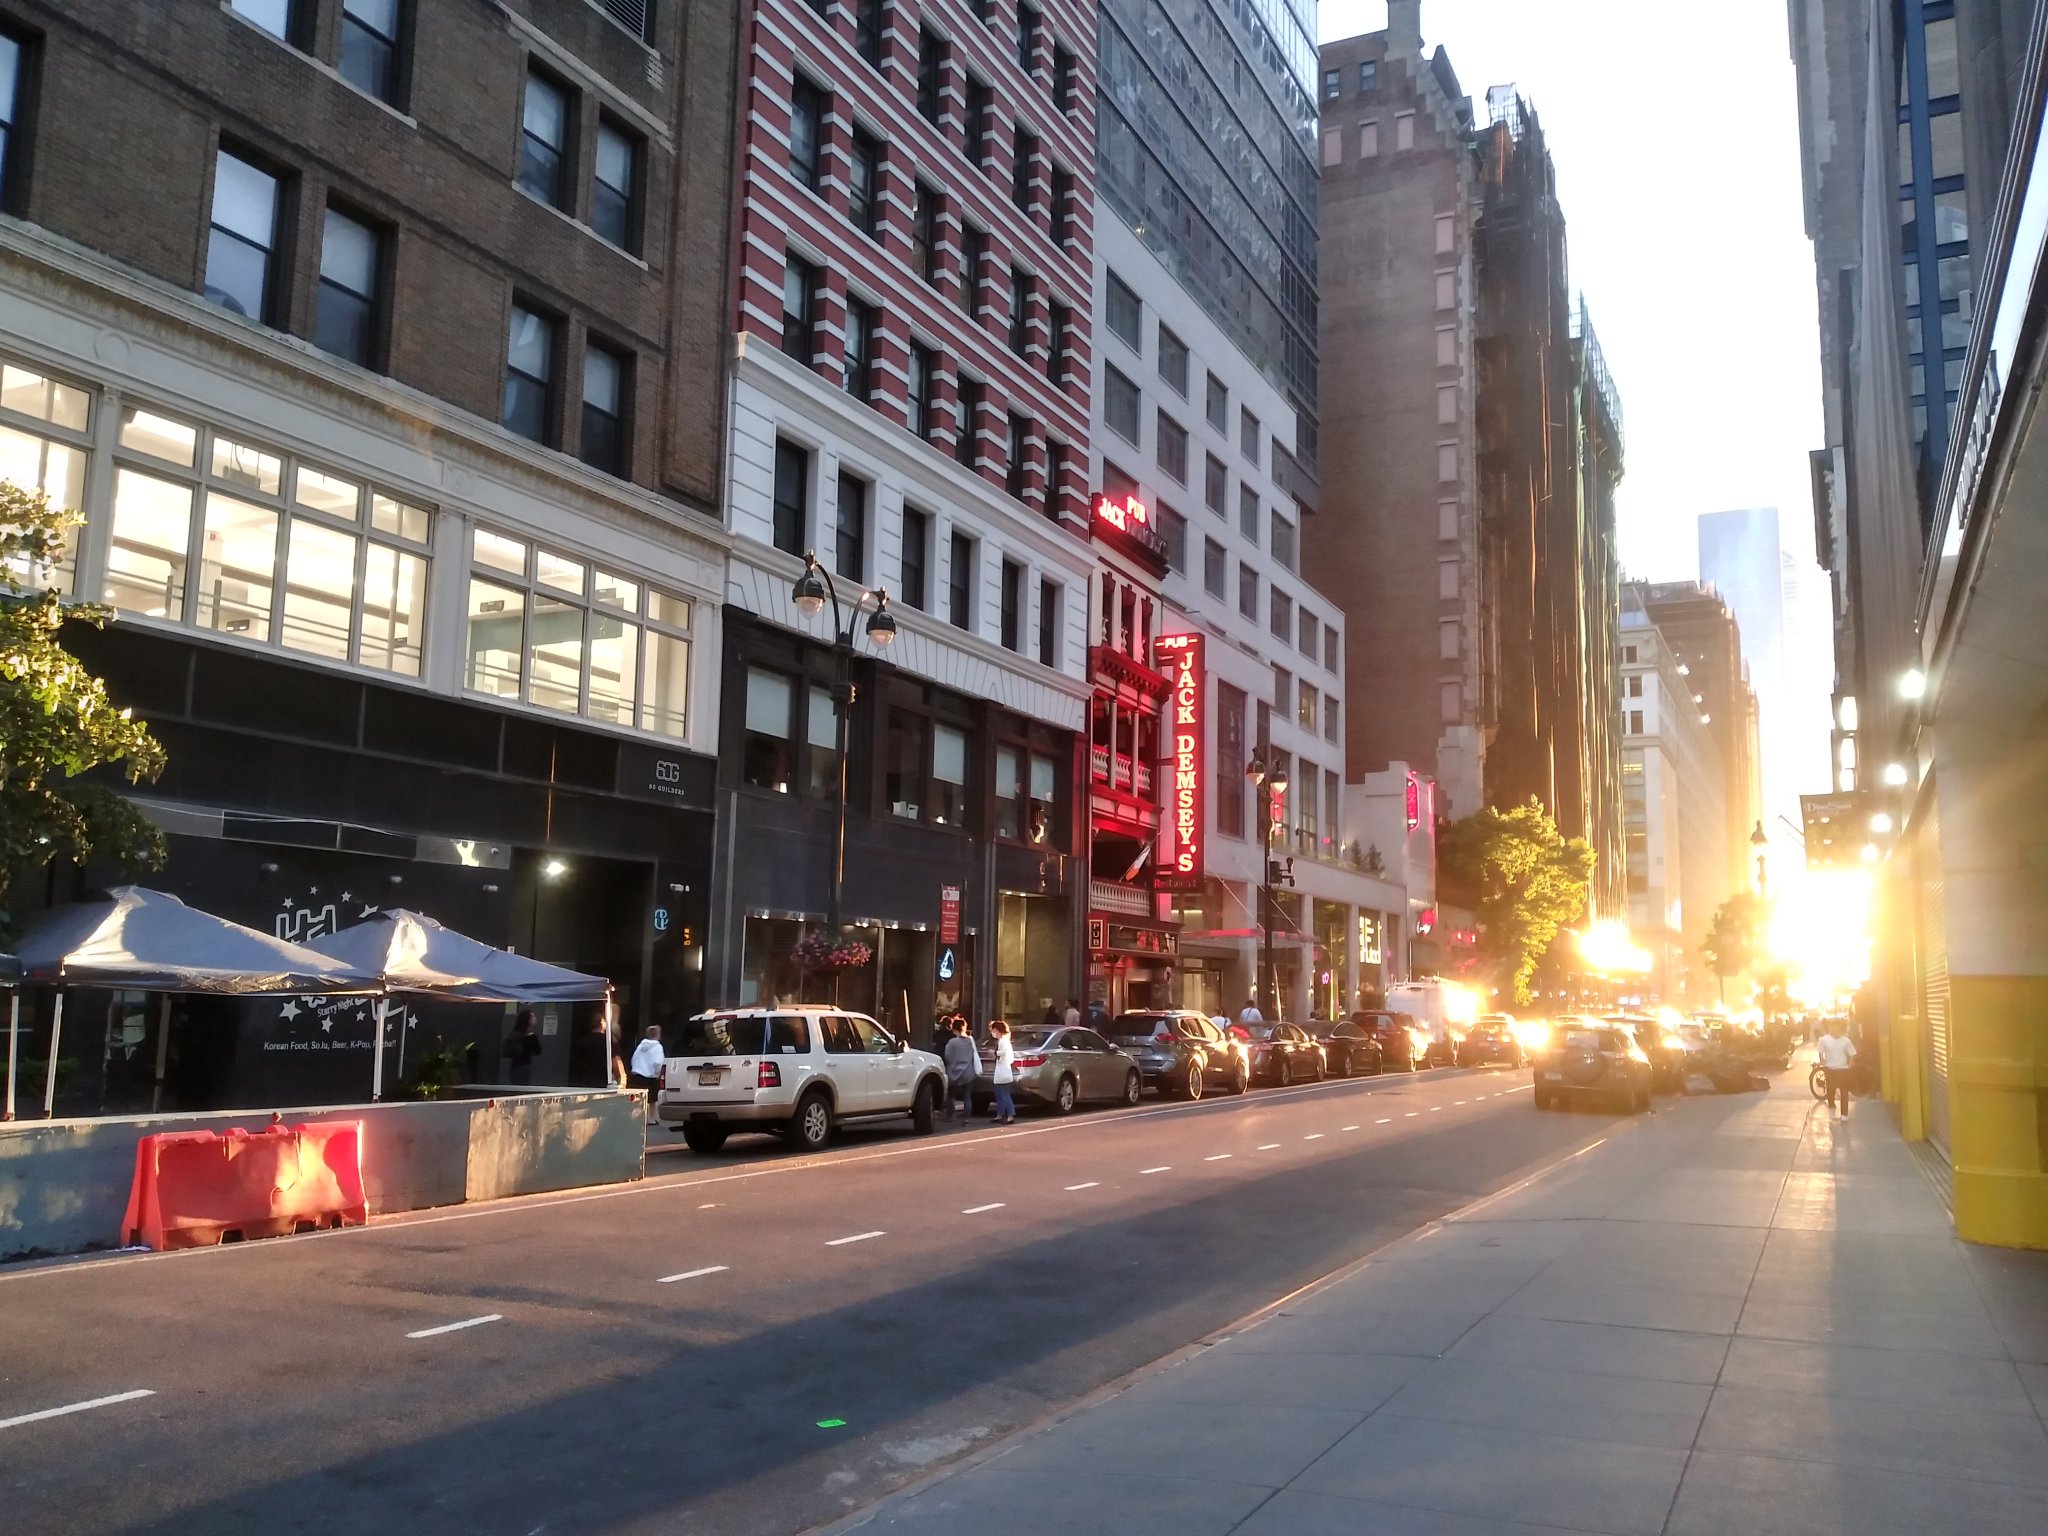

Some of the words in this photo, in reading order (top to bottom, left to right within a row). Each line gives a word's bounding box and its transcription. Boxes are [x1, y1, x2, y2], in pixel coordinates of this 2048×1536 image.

[1098, 498, 1126, 531] JACK
[1127, 496, 1146, 524] PUB
[1165, 637, 1188, 648] PUB
[1177, 652, 1196, 724] JACK
[1176, 735, 1197, 872] DEMSEY'S
[317, 1004, 337, 1017] Starry
[337, 998, 354, 1011] Night
[263, 1042, 289, 1050] Korean
[350, 1040, 371, 1050] K-Pop,
